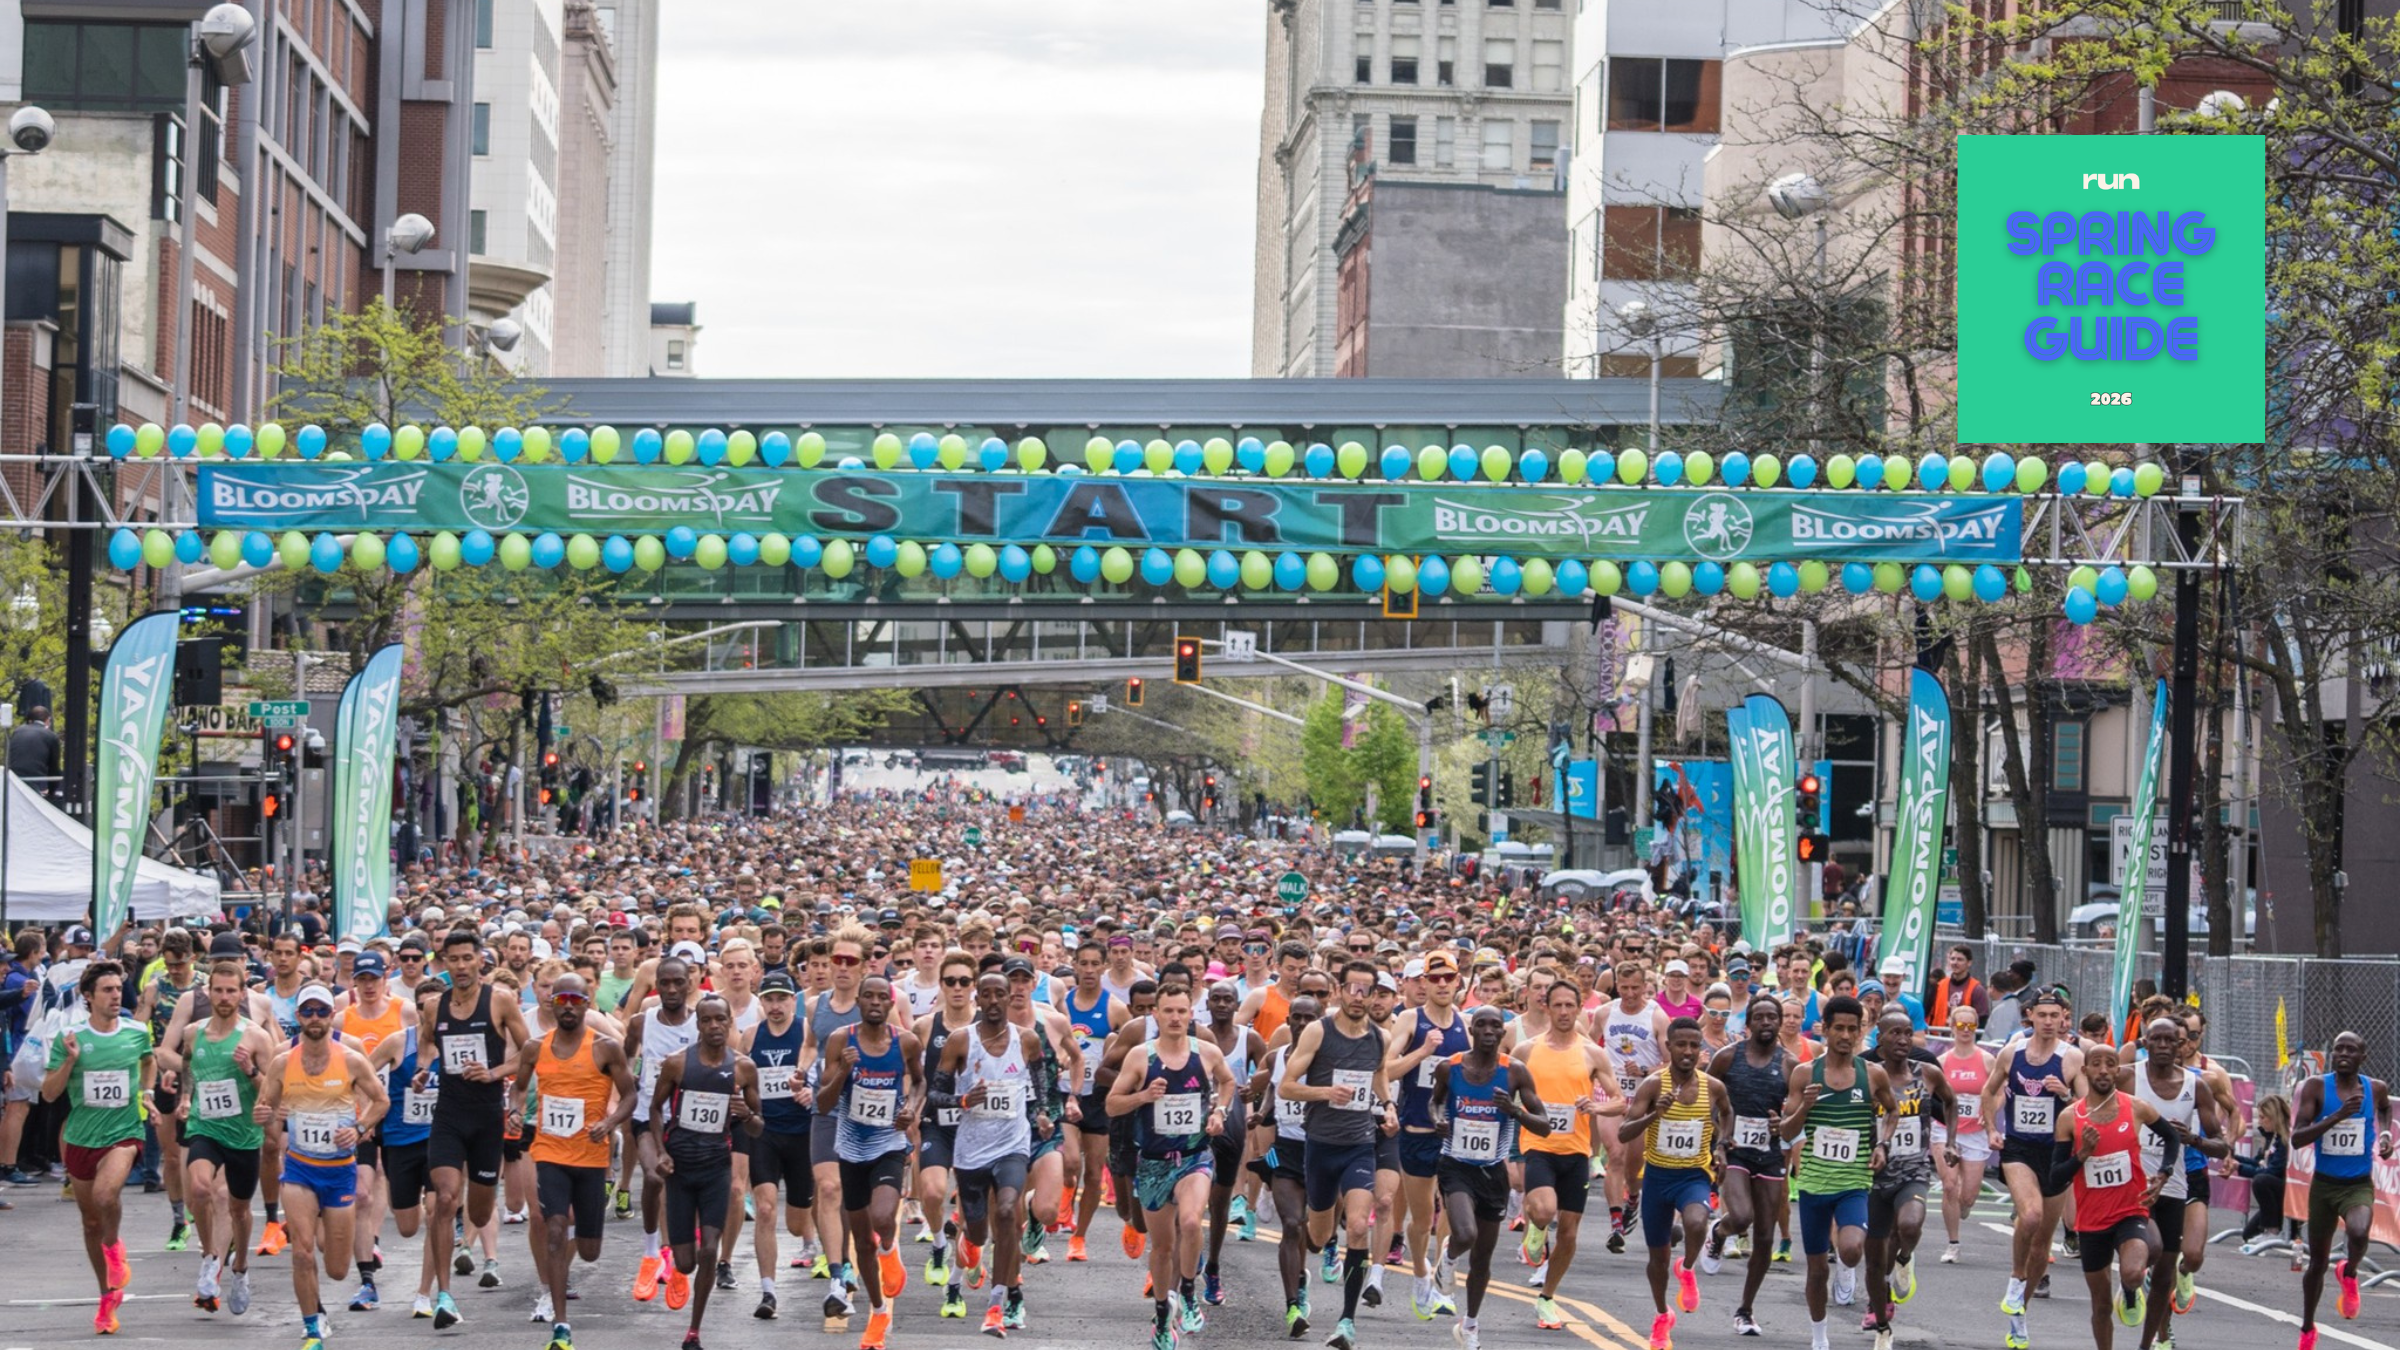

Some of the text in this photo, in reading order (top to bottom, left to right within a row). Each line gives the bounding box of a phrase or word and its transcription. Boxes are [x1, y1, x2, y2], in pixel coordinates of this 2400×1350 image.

[213, 477, 425, 509] BLOOMSDAY
[567, 480, 780, 512] BLOOMSDAY
[810, 476, 1410, 548] START
[1434, 506, 1647, 537] BLOOMSDAY
[1792, 510, 2003, 541] BLOOMSDAY
[261, 703, 297, 715] Post
[1757, 727, 1791, 947] LOOMSDAY
[2151, 828, 2169, 838] LAN
[1899, 706, 1940, 994] BLOOMSDAY
[912, 863, 942, 874] YELLOW
[1280, 882, 1308, 895] WALK
[451, 1049, 478, 1065] 151
[862, 1077, 896, 1087] DEPOT
[1616, 1078, 1636, 1090] 55
[93, 1085, 122, 1100] 120
[1351, 1087, 1367, 1102] 18
[205, 1095, 232, 1111] 115
[858, 1102, 886, 1119] 124
[981, 1096, 1010, 1111] 105
[1285, 1101, 1302, 1116] 13
[1465, 1105, 1498, 1115] DEPOT
[1877, 1098, 1921, 1116] AMY
[1957, 1105, 1973, 1116] 58
[549, 1112, 576, 1129] 117
[690, 1107, 719, 1124] 130
[1164, 1110, 1194, 1126] 132
[2021, 1110, 2047, 1125] 322
[1550, 1117, 1568, 1131] 52
[302, 1128, 331, 1144] 114
[1461, 1135, 1491, 1152] 106
[1666, 1134, 1695, 1150] 104
[1742, 1131, 1767, 1145] 126
[1895, 1132, 1914, 1147] 19
[2148, 1133, 2165, 1147] 12
[2330, 1132, 2358, 1147] 107
[1822, 1142, 1850, 1160] 110
[2094, 1168, 2123, 1186] 101
